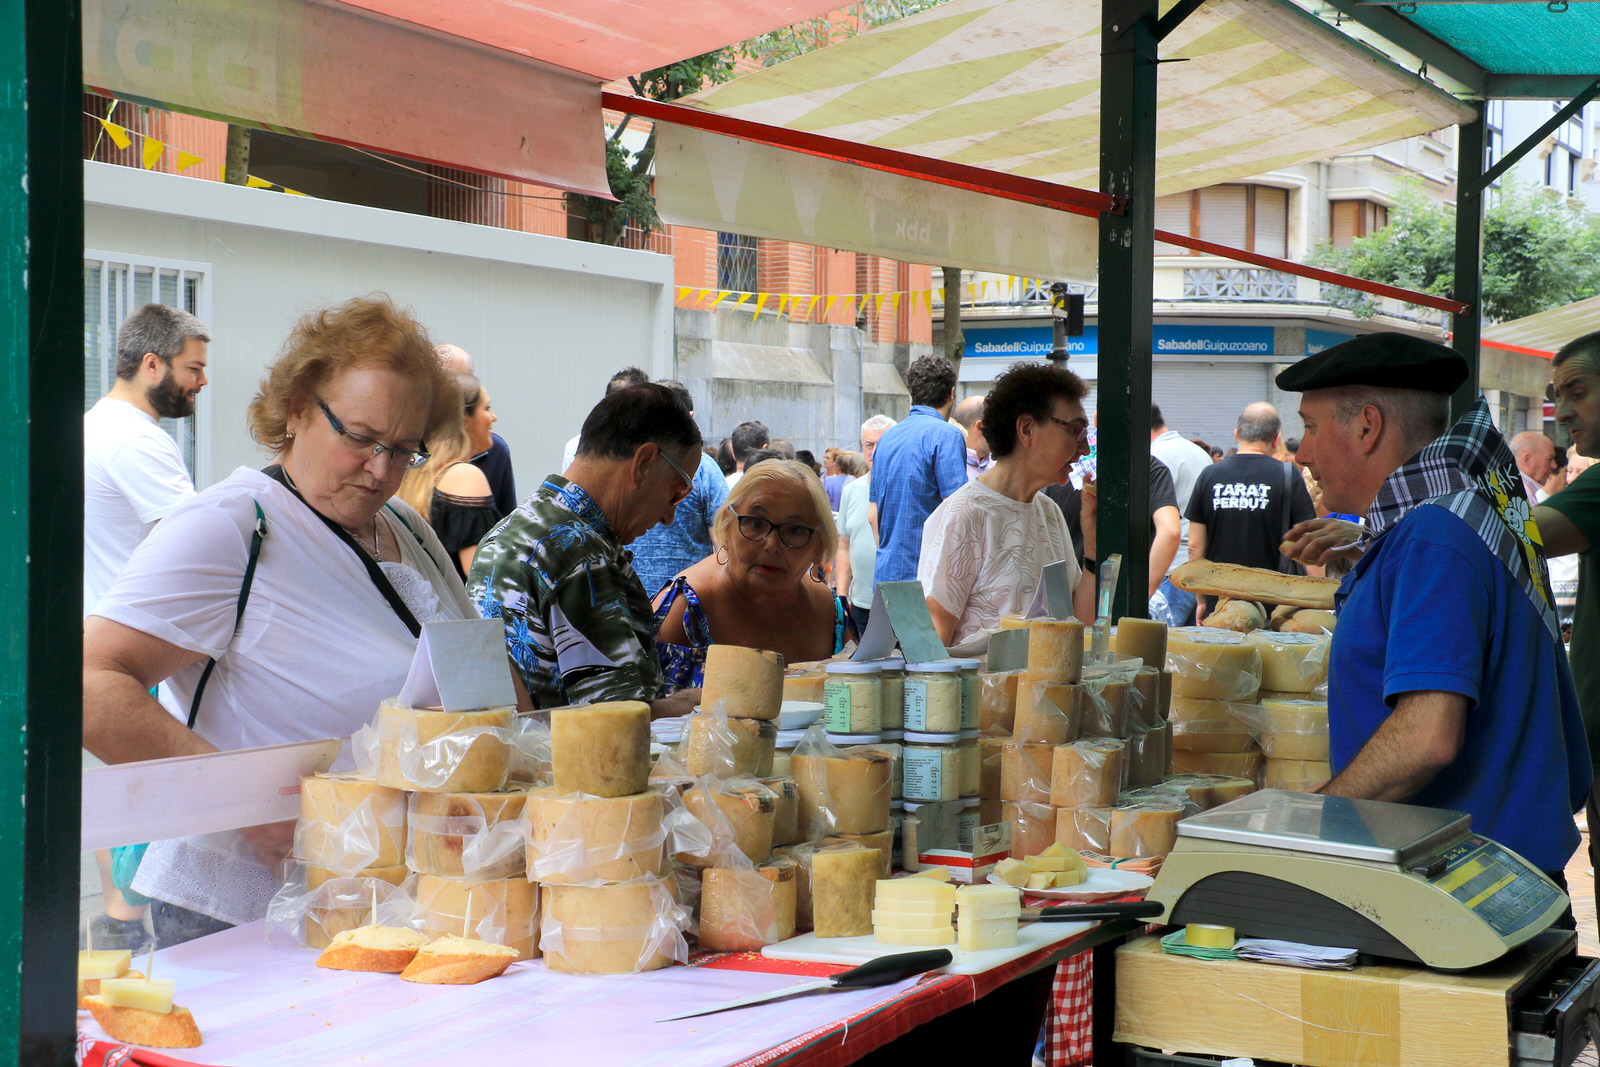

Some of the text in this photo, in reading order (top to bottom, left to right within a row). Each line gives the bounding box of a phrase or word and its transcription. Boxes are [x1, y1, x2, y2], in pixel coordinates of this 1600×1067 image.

[974, 341, 1085, 354] SabadellGuipuzano
[1157, 339, 1268, 352] SabadellGuipuzcoano
[1212, 482, 1271, 498] TARAT
[1213, 497, 1269, 511] PERDUT
